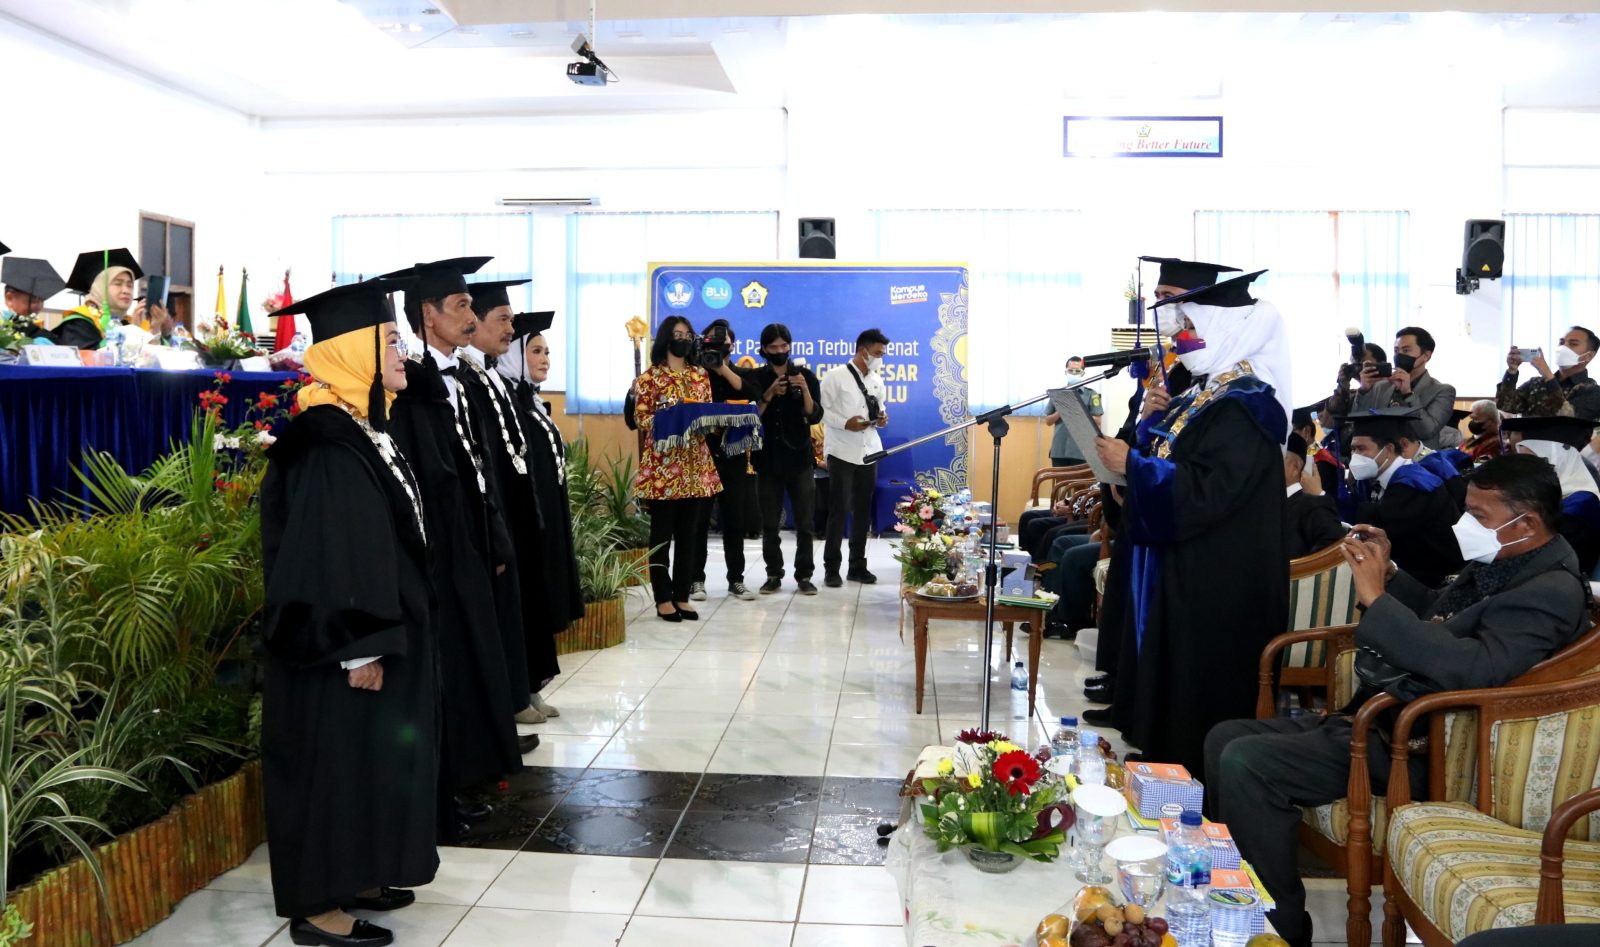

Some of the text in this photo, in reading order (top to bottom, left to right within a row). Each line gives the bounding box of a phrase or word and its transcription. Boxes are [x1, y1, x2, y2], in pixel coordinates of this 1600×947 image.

[1137, 139, 1170, 150] Better
[1174, 139, 1212, 150] Future
[817, 339, 857, 356] Terbu
[885, 339, 919, 356] enat
[877, 363, 918, 382] ESAR
